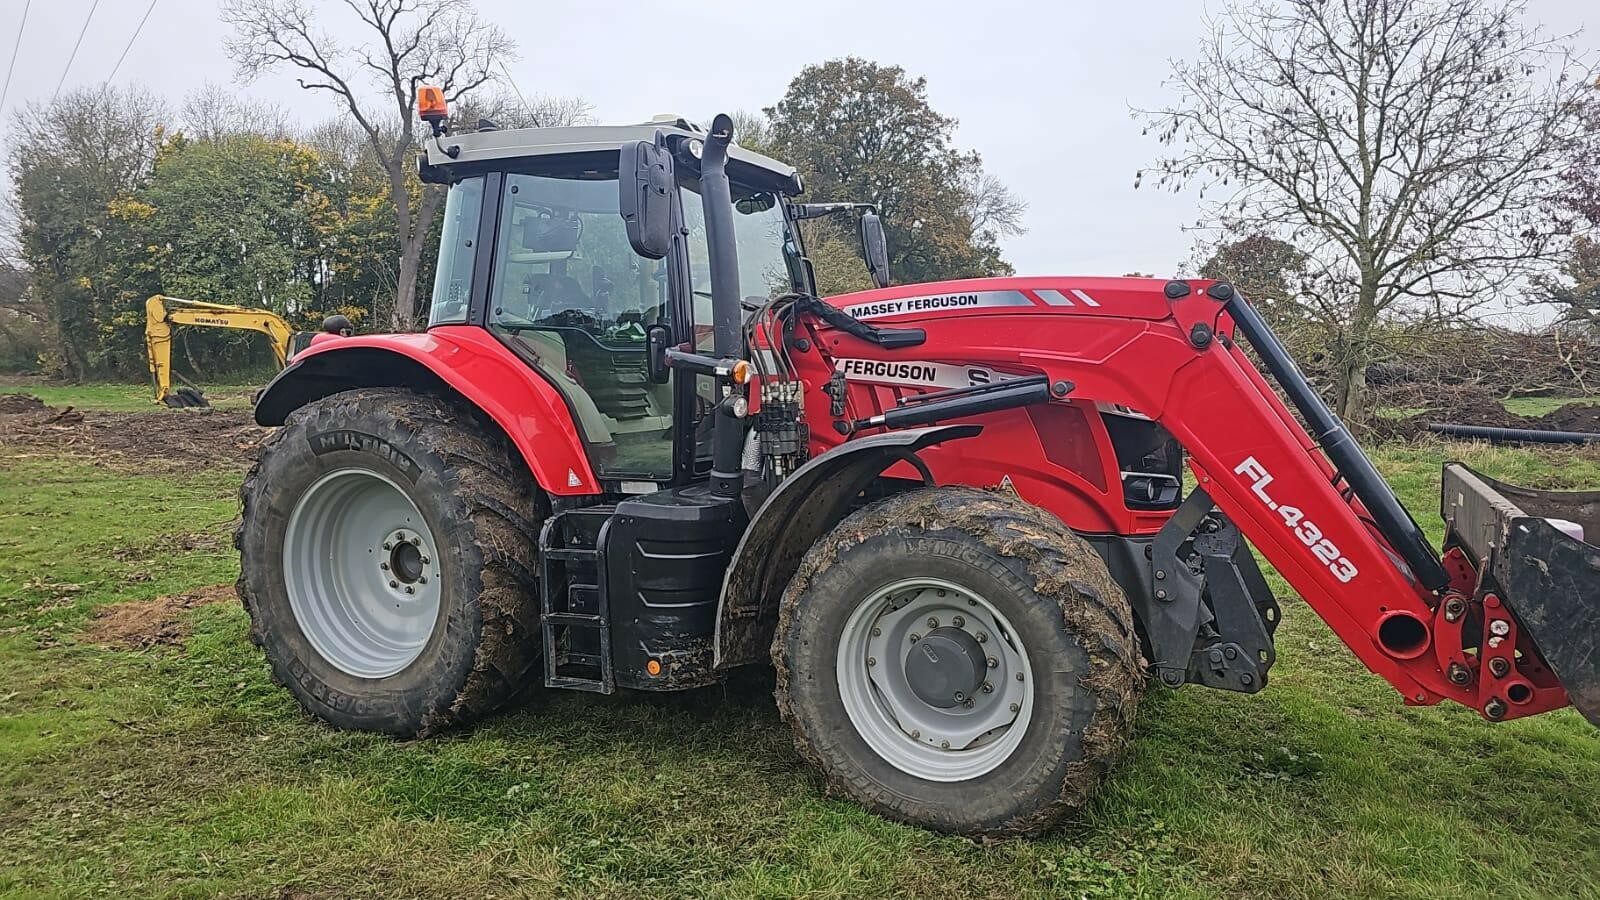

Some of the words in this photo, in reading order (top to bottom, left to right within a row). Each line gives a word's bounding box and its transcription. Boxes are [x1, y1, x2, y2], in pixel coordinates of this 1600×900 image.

[851, 302, 902, 318] MASSEY
[907, 295, 978, 311] FERGUSON
[844, 359, 937, 382] FERGUSON
[1233, 455, 1359, 583] FL.4323
